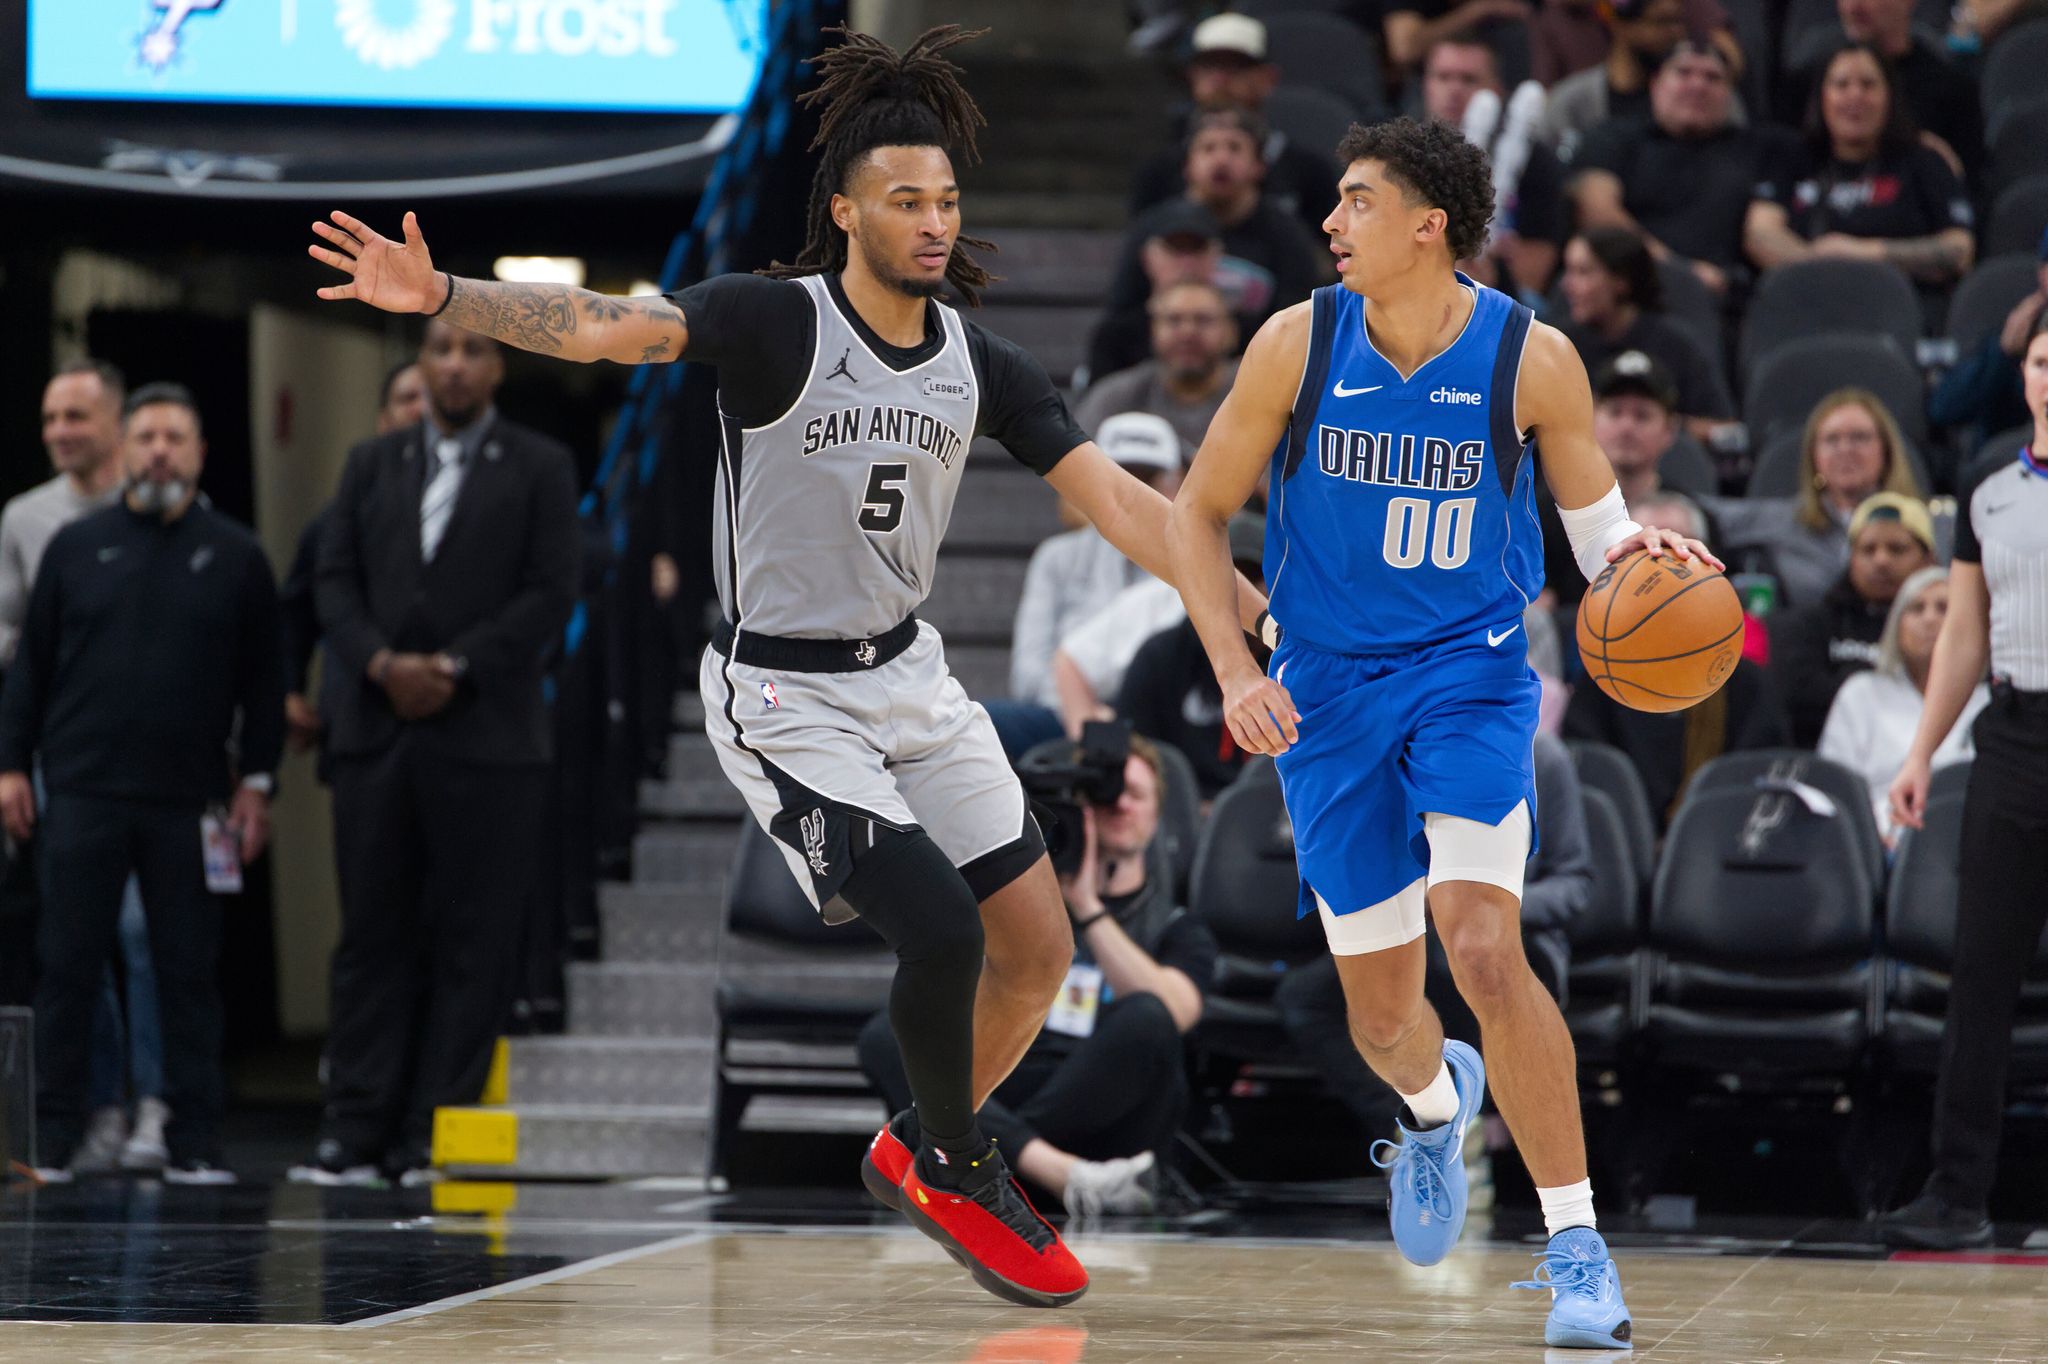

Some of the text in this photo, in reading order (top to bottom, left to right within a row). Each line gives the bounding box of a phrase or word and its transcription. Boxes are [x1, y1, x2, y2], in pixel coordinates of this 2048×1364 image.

[464, 0, 678, 56] Frost
[929, 382, 964, 395] LEDGER
[1429, 387, 1482, 405] chime
[802, 405, 963, 472] SAN ANTONIO
[1319, 424, 1485, 491] DALLAS
[856, 462, 911, 535] 5
[1383, 497, 1477, 570] 00
